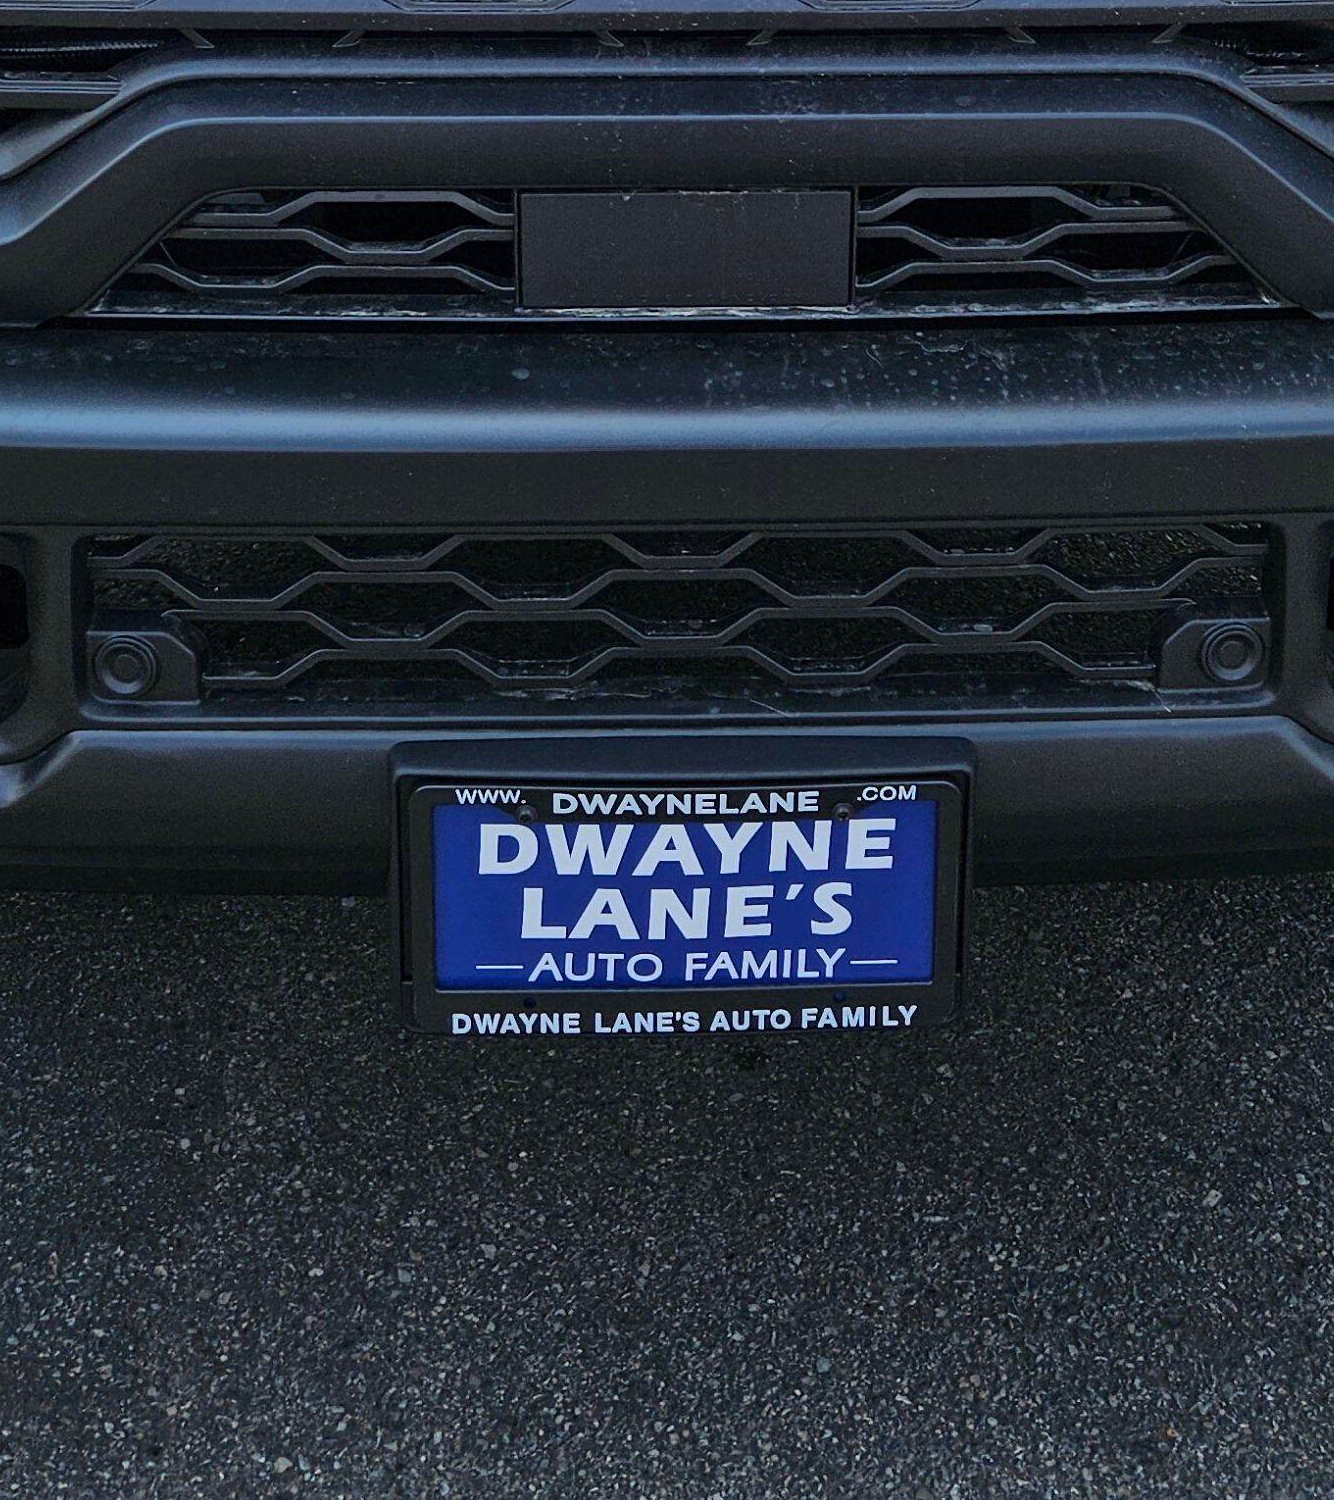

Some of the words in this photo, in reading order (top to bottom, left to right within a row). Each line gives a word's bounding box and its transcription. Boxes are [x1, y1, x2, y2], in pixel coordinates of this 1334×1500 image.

[552, 790, 820, 815] DWAYNELANE
[855, 784, 917, 802] .COM
[478, 818, 897, 877] DWAYNE
[520, 881, 853, 940] LANE'S
[527, 952, 663, 982] AUTO
[684, 947, 846, 982] FAMILY
[452, 1012, 581, 1035] DWAYNE
[594, 1011, 700, 1034] LANE'S
[709, 1008, 792, 1032] AUTO
[800, 1004, 918, 1030] FAMILY
